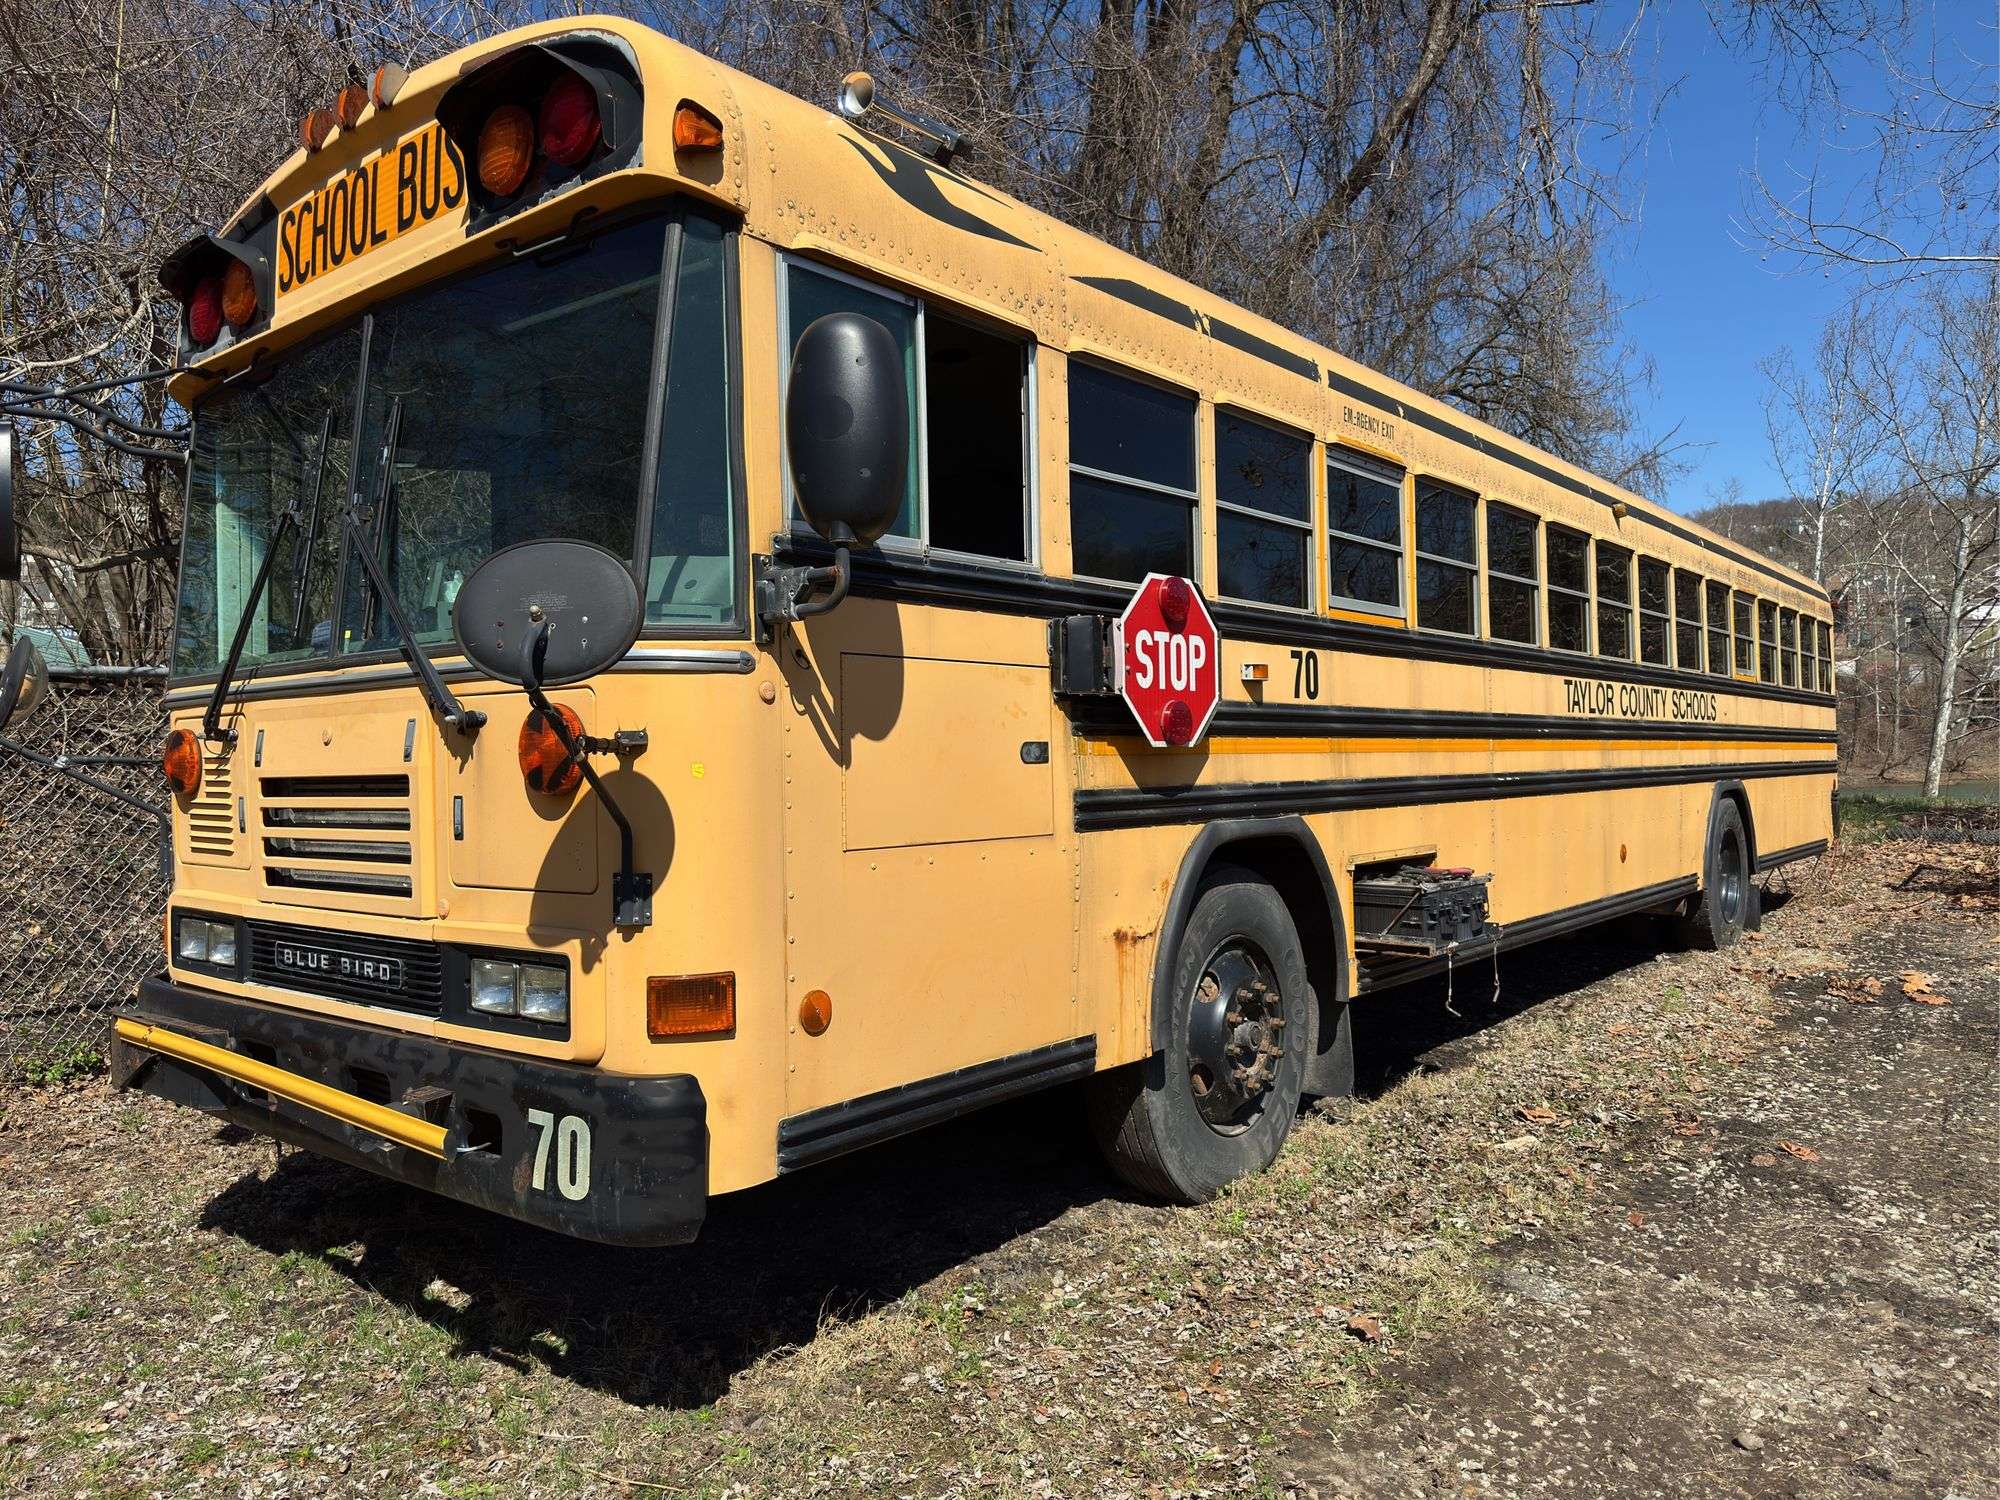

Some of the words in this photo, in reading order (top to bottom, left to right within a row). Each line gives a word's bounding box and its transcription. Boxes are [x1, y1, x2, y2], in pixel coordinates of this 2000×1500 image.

[279, 159, 388, 293] SCHOOL
[398, 126, 465, 234] BUS
[1381, 421, 1395, 441] EXIT
[1135, 628, 1207, 692] STOP
[1290, 649, 1320, 701] 70
[1564, 679, 1615, 715] TAYLOR
[1619, 684, 1668, 718] COUNTY
[1671, 690, 1718, 722] SCHOOLS
[283, 948, 330, 969] BLUE
[340, 956, 391, 981] BIRD
[527, 1107, 592, 1201] 70
